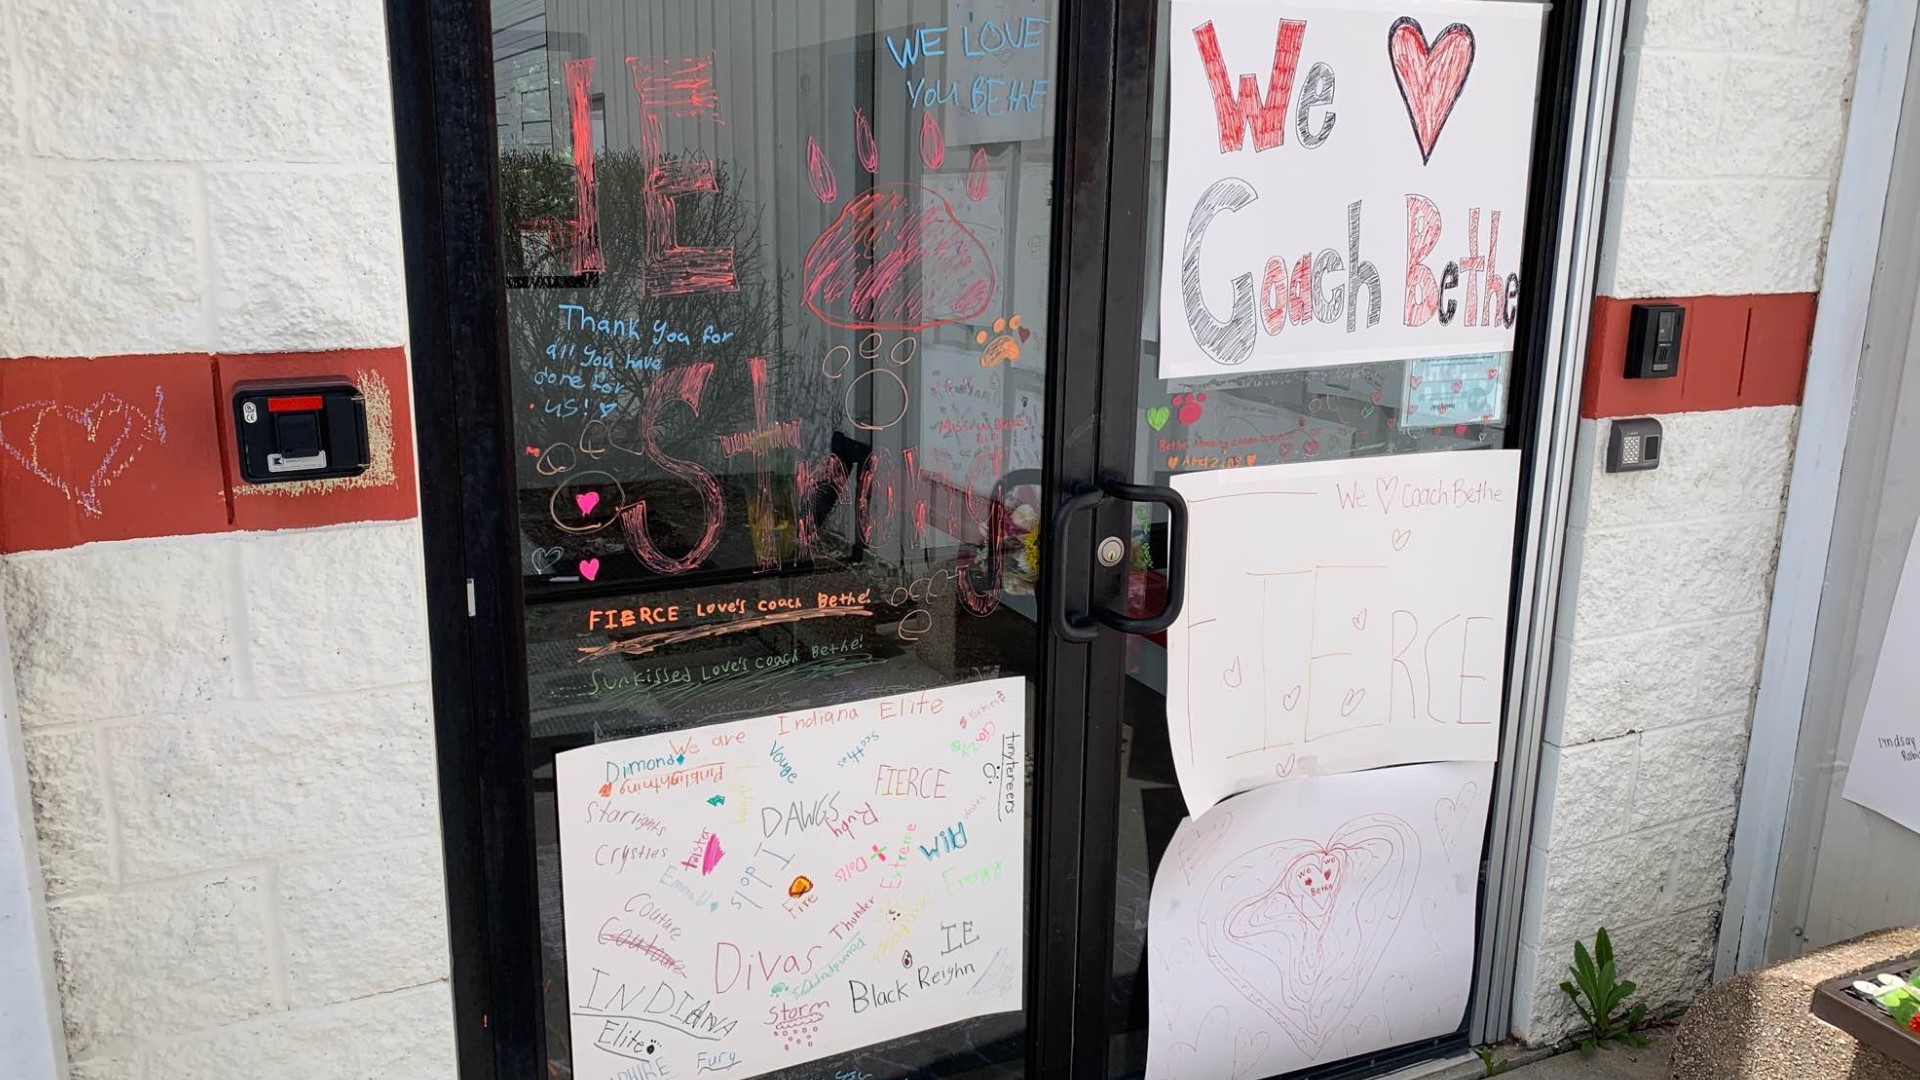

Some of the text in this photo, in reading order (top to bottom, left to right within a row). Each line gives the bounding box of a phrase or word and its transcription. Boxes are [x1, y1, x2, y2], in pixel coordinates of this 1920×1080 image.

[886, 15, 1051, 69] WE LOVE
[1192, 18, 1336, 153] We
[1402, 193, 1521, 329] Bethe
[558, 304, 641, 341] Thank
[703, 324, 734, 344] for
[546, 344, 574, 360] all
[624, 354, 663, 371] have
[534, 366, 625, 394] done for
[1336, 478, 1504, 509] We Coach Bethe
[589, 605, 679, 630] FIERCE
[1186, 490, 1494, 767] FIERCE
[669, 692, 944, 755] We are Indiana Elite
[606, 754, 675, 784] Dimond
[768, 739, 798, 784] Vouge
[875, 764, 952, 799] FIERCE
[761, 791, 841, 838] DAWGS
[824, 802, 879, 840] Ruby
[918, 821, 968, 862] Wild
[782, 894, 819, 919] Fire
[829, 896, 875, 940] Thunder
[940, 920, 980, 956] IE
[715, 941, 822, 995] Divas
[849, 961, 976, 1014] Black Reighn
[578, 967, 739, 1037] INDIANA
[763, 998, 831, 1026] Storm
[597, 1019, 645, 1054] Elite
[697, 1051, 738, 1072] Fury
